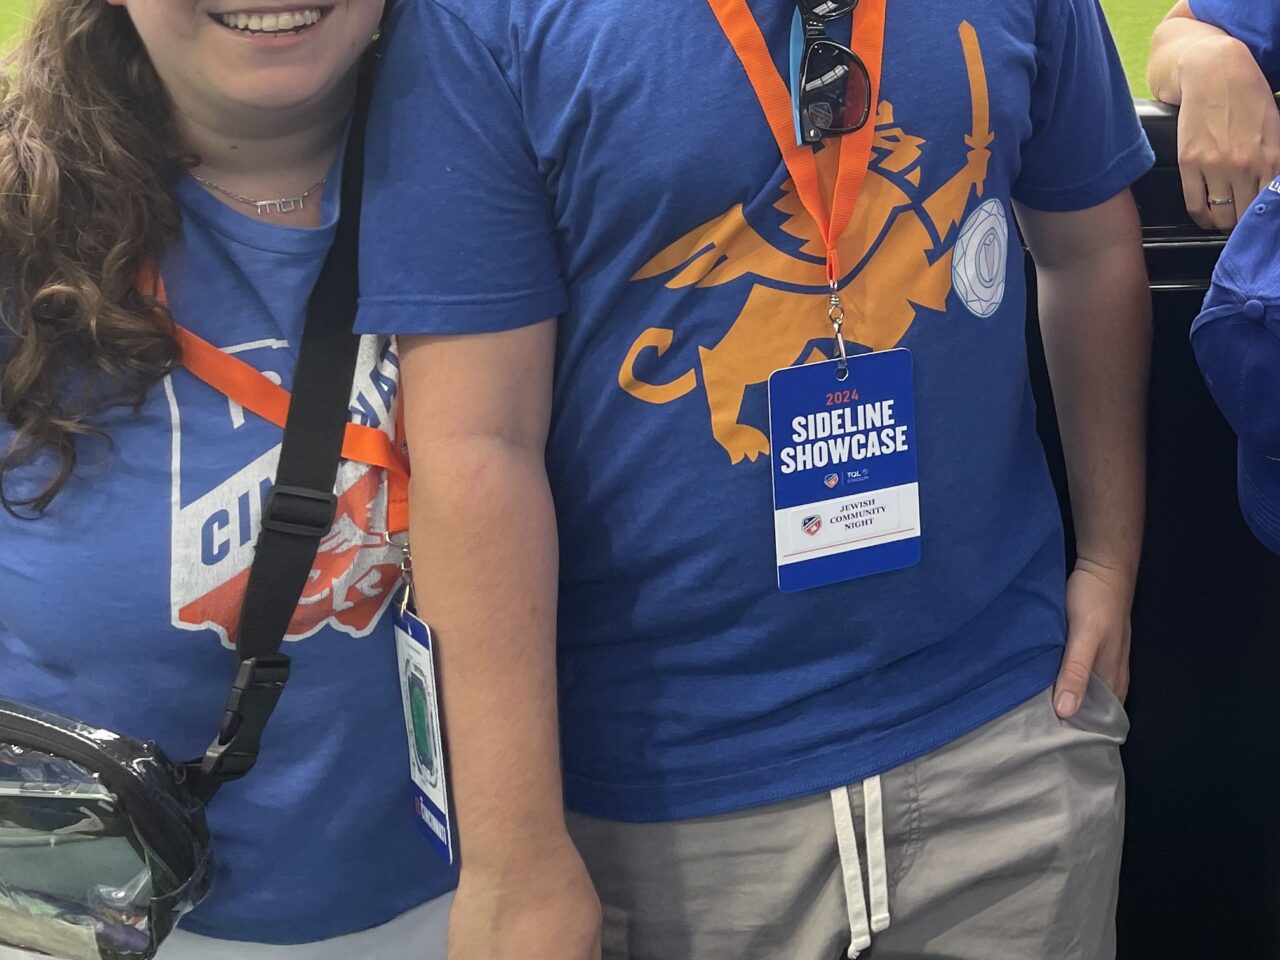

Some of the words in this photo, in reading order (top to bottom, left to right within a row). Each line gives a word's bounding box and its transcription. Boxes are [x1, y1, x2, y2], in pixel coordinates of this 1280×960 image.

[825, 389, 859, 406] 2024
[792, 400, 895, 443] SIDELINE
[780, 425, 909, 474] SHOWCASE
[840, 498, 876, 513] JEWISH
[829, 505, 887, 525] COMMUNITY
[844, 517, 874, 531] NIGHT
